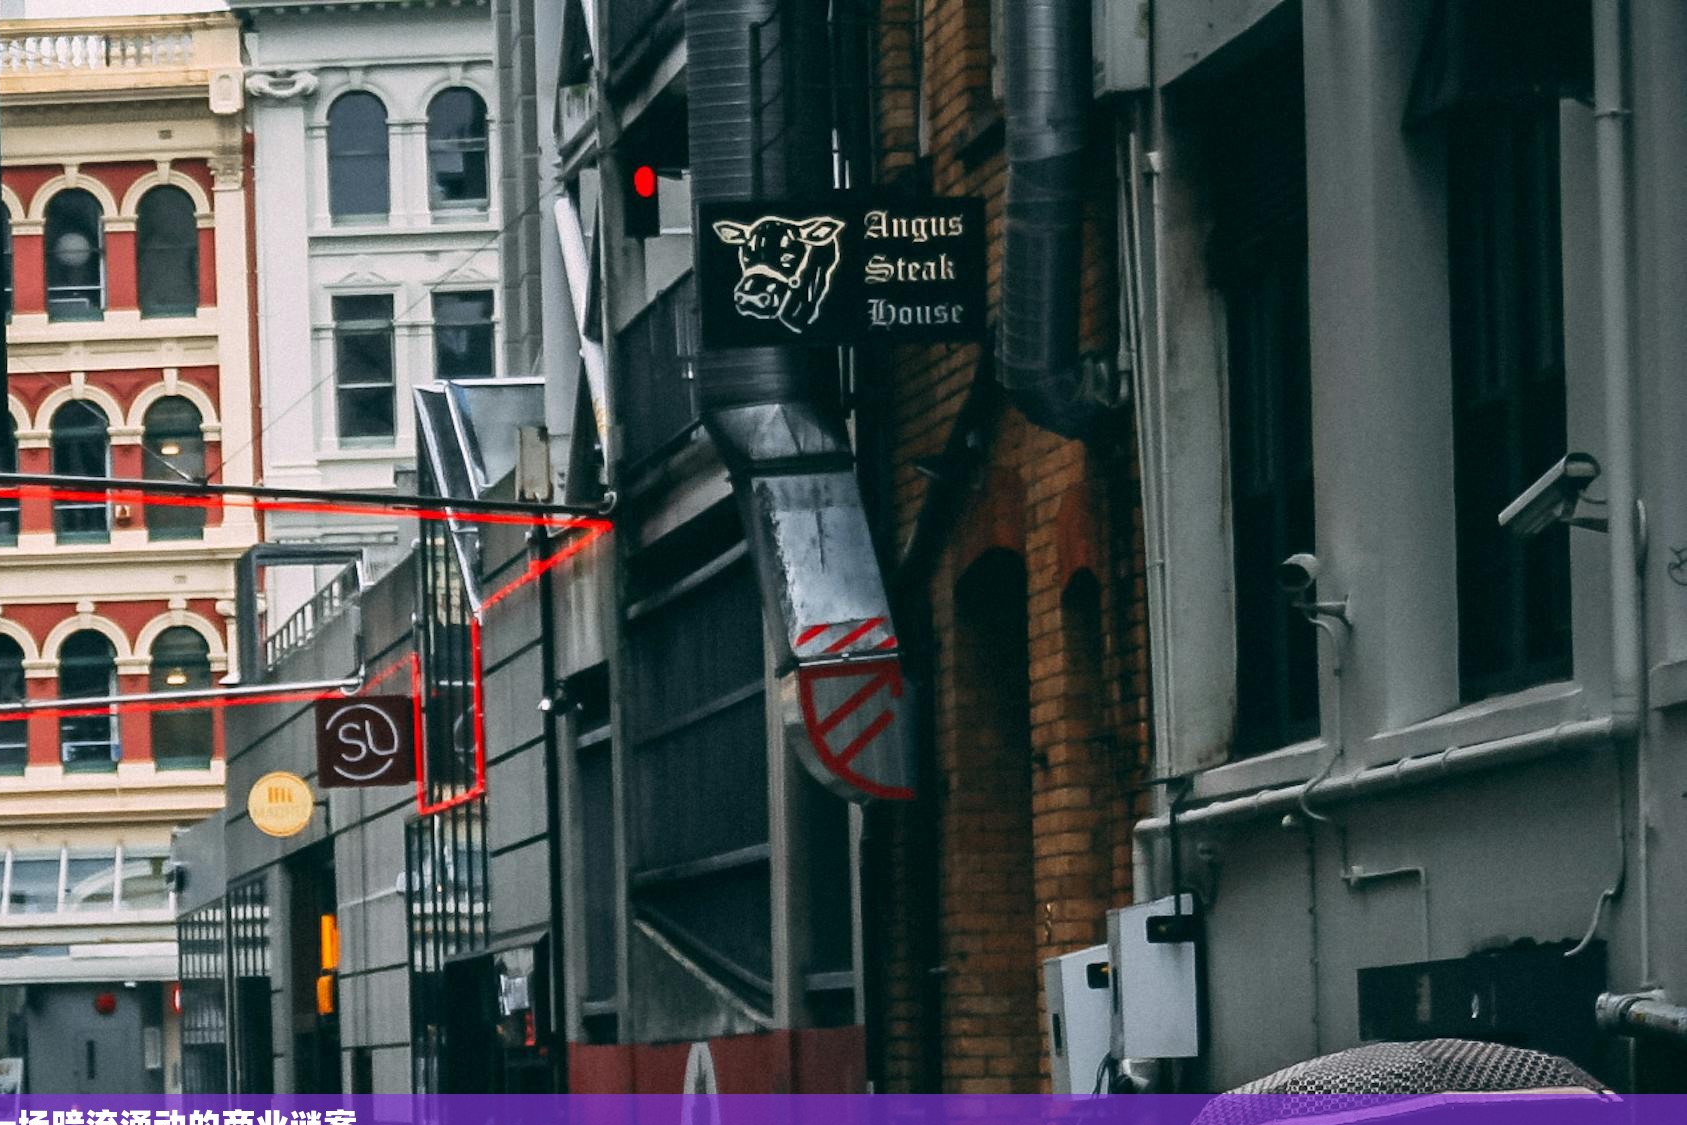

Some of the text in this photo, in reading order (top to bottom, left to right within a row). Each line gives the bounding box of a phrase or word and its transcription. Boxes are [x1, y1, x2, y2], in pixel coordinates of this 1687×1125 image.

[863, 209, 964, 243] Angus
[864, 253, 955, 284] Steak
[867, 298, 964, 329] House
